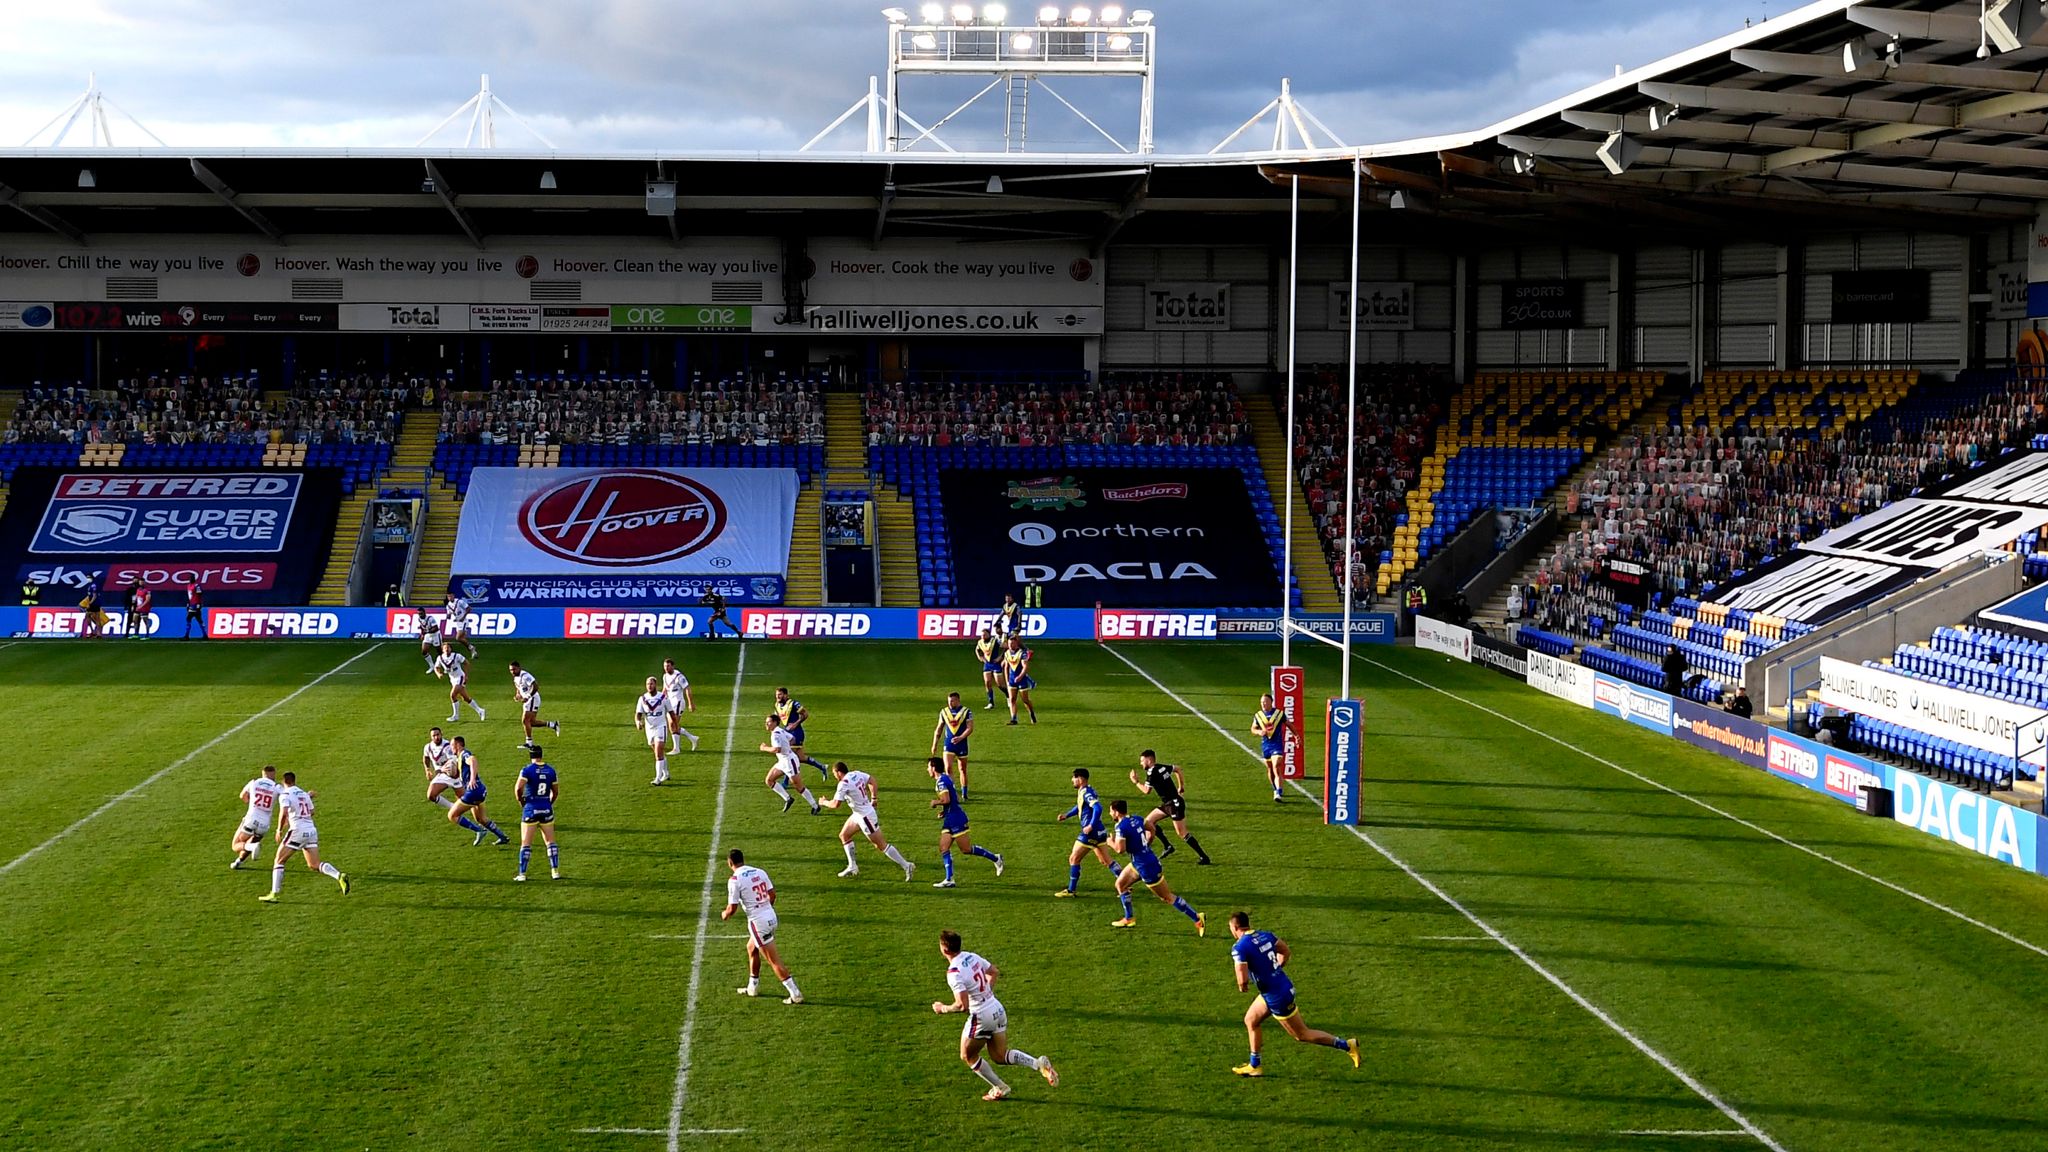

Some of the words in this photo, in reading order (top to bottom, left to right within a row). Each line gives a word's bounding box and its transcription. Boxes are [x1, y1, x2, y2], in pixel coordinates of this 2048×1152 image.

[58, 256, 90, 269] Chill
[97, 257, 121, 269] the
[130, 259, 159, 272] way
[165, 260, 192, 272] you
[199, 256, 224, 269] live
[275, 257, 330, 270] Hoover.
[336, 258, 374, 271] Wash
[380, 258, 404, 271] the
[407, 260, 436, 274] way
[441, 260, 468, 274] you
[477, 258, 503, 272] live
[554, 259, 609, 273] Hoover.
[614, 259, 654, 273] Clean
[658, 259, 683, 273] the
[688, 261, 717, 276] way
[722, 261, 749, 276] you
[753, 259, 778, 273] live
[831, 261, 885, 274] Hoover.
[892, 261, 928, 274] Cook
[935, 261, 959, 275] the
[965, 264, 993, 276] way
[1000, 264, 1025, 277] you
[1029, 262, 1055, 275] live
[1335, 287, 1409, 316] Total
[1515, 286, 1565, 298] SPORTS
[1150, 288, 1225, 317] Total
[202, 314, 225, 322] Every
[254, 314, 276, 322] Every
[299, 314, 322, 322] Every
[387, 305, 439, 325] Total
[543, 319, 571, 329] 01925
[573, 319, 589, 328] 244
[592, 319, 609, 328] 244
[627, 308, 665, 323] one
[697, 308, 735, 323] one
[810, 310, 1039, 332] halliwelljones.co.uk
[65, 477, 289, 496] BETFRED
[1941, 452, 2048, 504] BLA
[1108, 485, 1182, 499] Batchelors
[142, 509, 279, 526] SUPER
[136, 527, 275, 541] LEAGUE
[1062, 524, 1205, 538] northern
[1829, 503, 2023, 560] LIVES
[27, 566, 102, 589] sky
[115, 567, 264, 586] sports
[1013, 562, 1218, 582] DACIA
[497, 587, 647, 599] WARRINGTON
[652, 586, 745, 598] WOLES
[504, 580, 586, 588] PRINCIPAL
[590, 580, 633, 588] CLUB
[636, 580, 720, 588] SPONSOR
[721, 579, 738, 588] OF
[212, 612, 339, 635] BETFRED
[569, 612, 694, 636] BETFRED
[747, 613, 871, 636] BETFRED
[923, 614, 1047, 637] BETFRED
[1102, 614, 1217, 637] BETFRED
[1219, 621, 1275, 632] BETFRED
[1298, 621, 1334, 632] SUPER
[1335, 621, 1382, 632] LAGUE
[1530, 654, 1554, 679] DANIEL
[1554, 660, 1577, 686] JAMES
[1820, 671, 1866, 702] HALLIWELL
[1868, 684, 1898, 709] JONES
[1923, 700, 1979, 732] HALLIWELL
[1982, 715, 2017, 741] JONES
[1283, 696, 1296, 776] BEFRED
[1692, 719, 1766, 758] northernrailway.co.uk
[1770, 740, 1818, 780] BETFRED
[1335, 731, 1350, 821] BETFRED
[537, 782, 547, 795] 8
[254, 793, 272, 808] 29
[299, 802, 310, 816] 21
[1894, 769, 2022, 868] DACIA
[752, 881, 768, 901] 39
